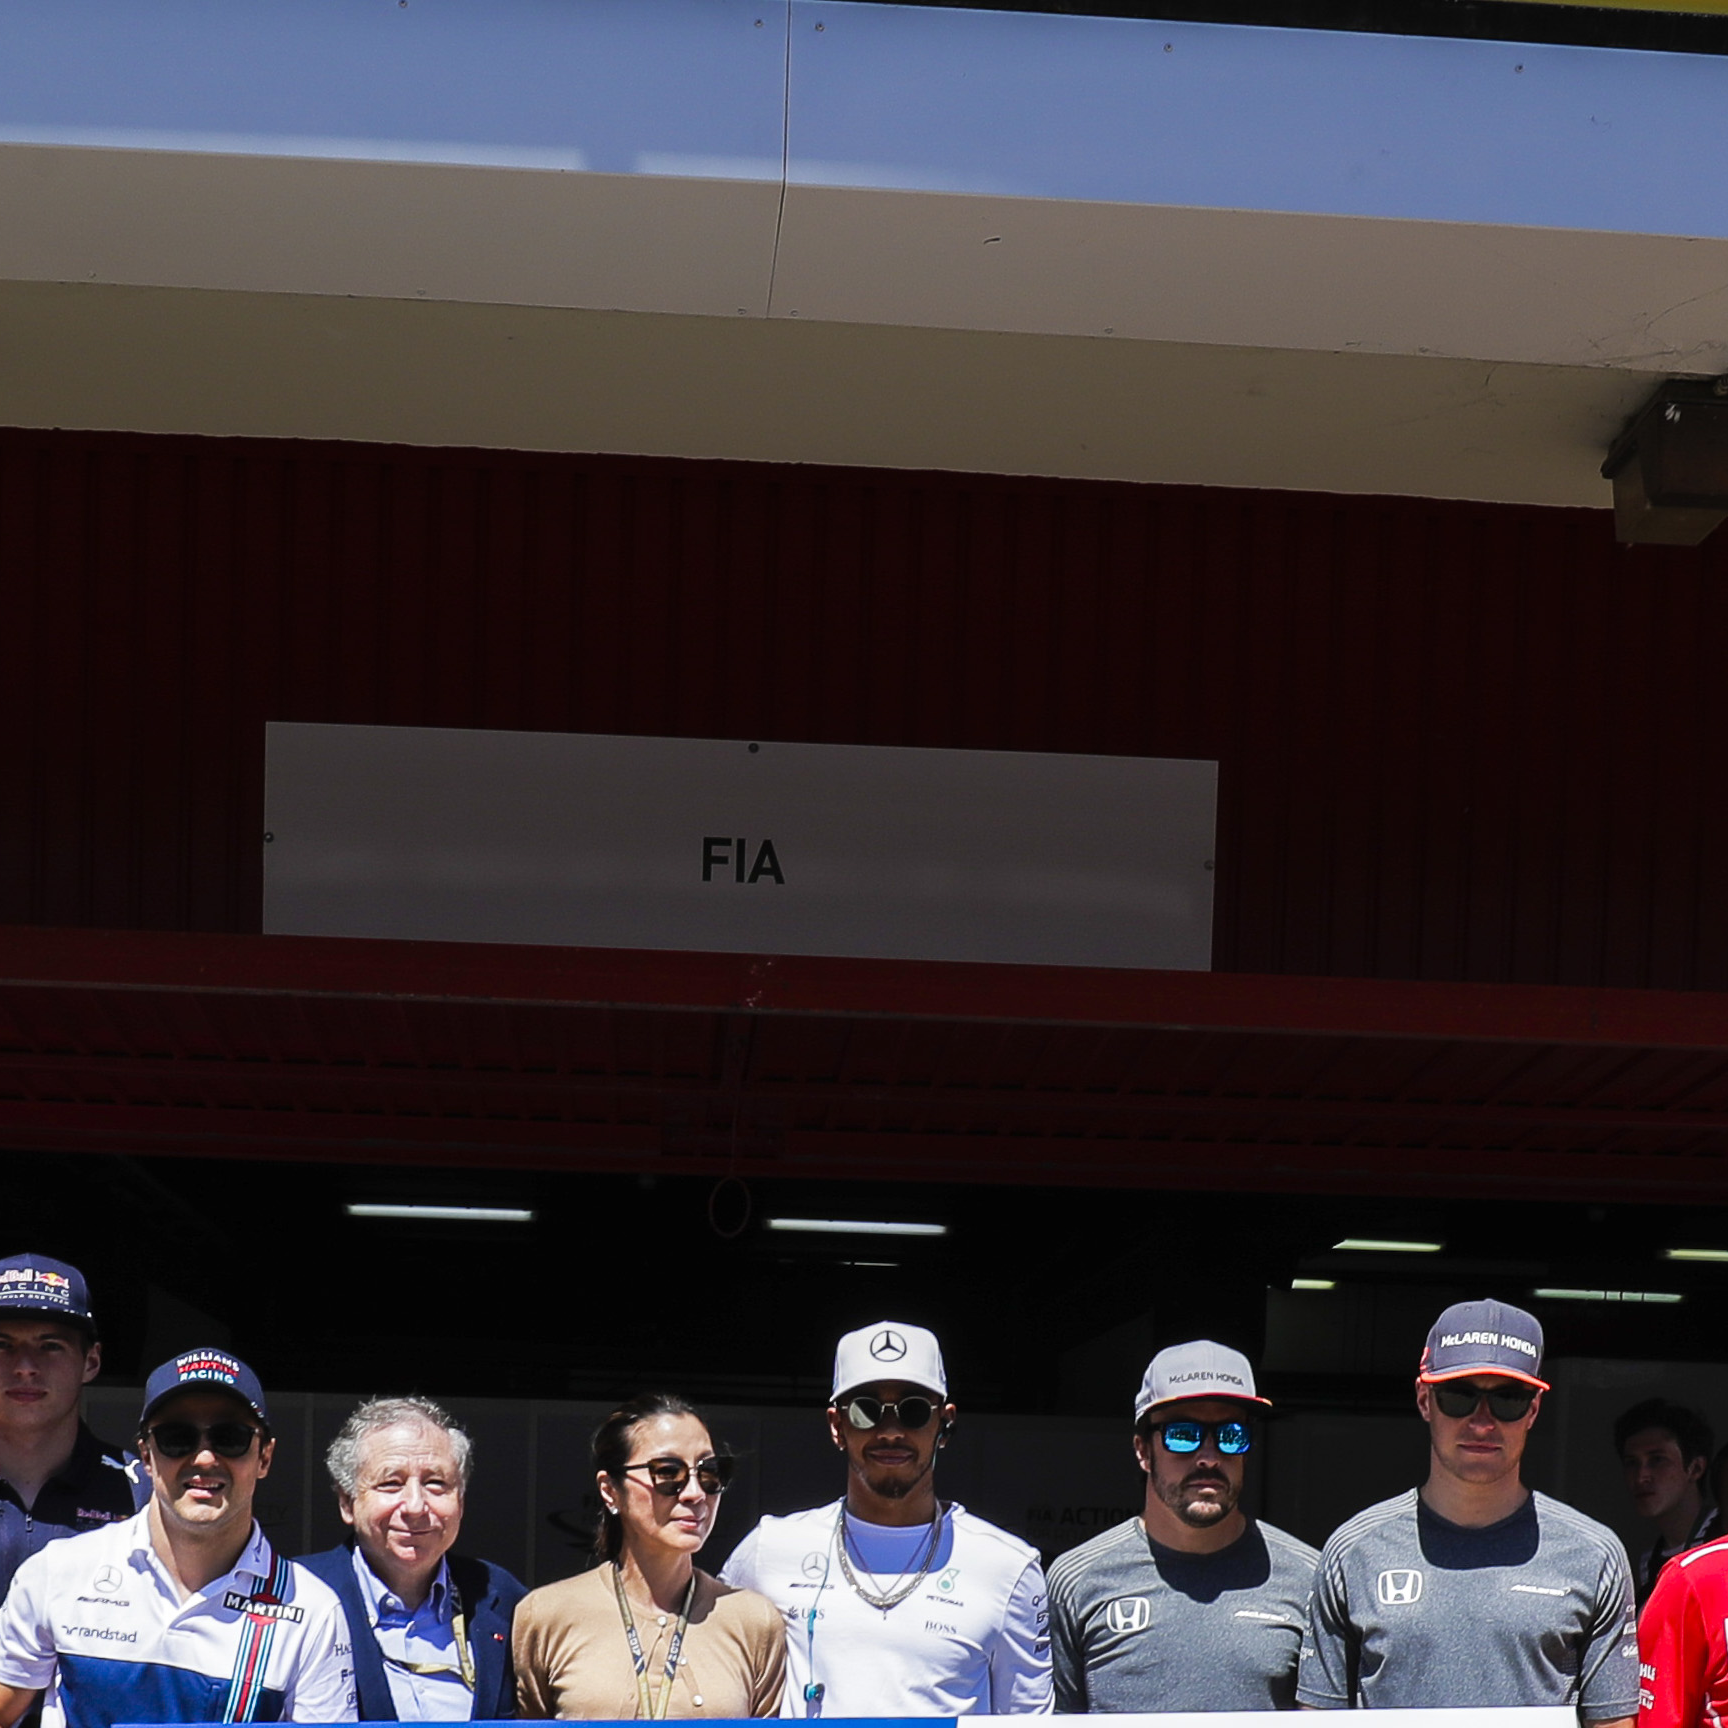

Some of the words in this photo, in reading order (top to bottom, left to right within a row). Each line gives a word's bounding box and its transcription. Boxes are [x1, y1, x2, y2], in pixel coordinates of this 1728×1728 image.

[702, 837, 785, 884] FIA
[1441, 1331, 1499, 1347] McLAREN
[1501, 1334, 1537, 1358] HONDA
[177, 1351, 240, 1372] WILLIAMS
[180, 1369, 237, 1385] RACING
[1169, 1371, 1213, 1385] McLAREN
[1216, 1373, 1243, 1387] HONDA
[226, 1594, 302, 1622] MARTINI
[78, 1627, 136, 1643] randstad
[925, 1620, 957, 1634] BOSS
